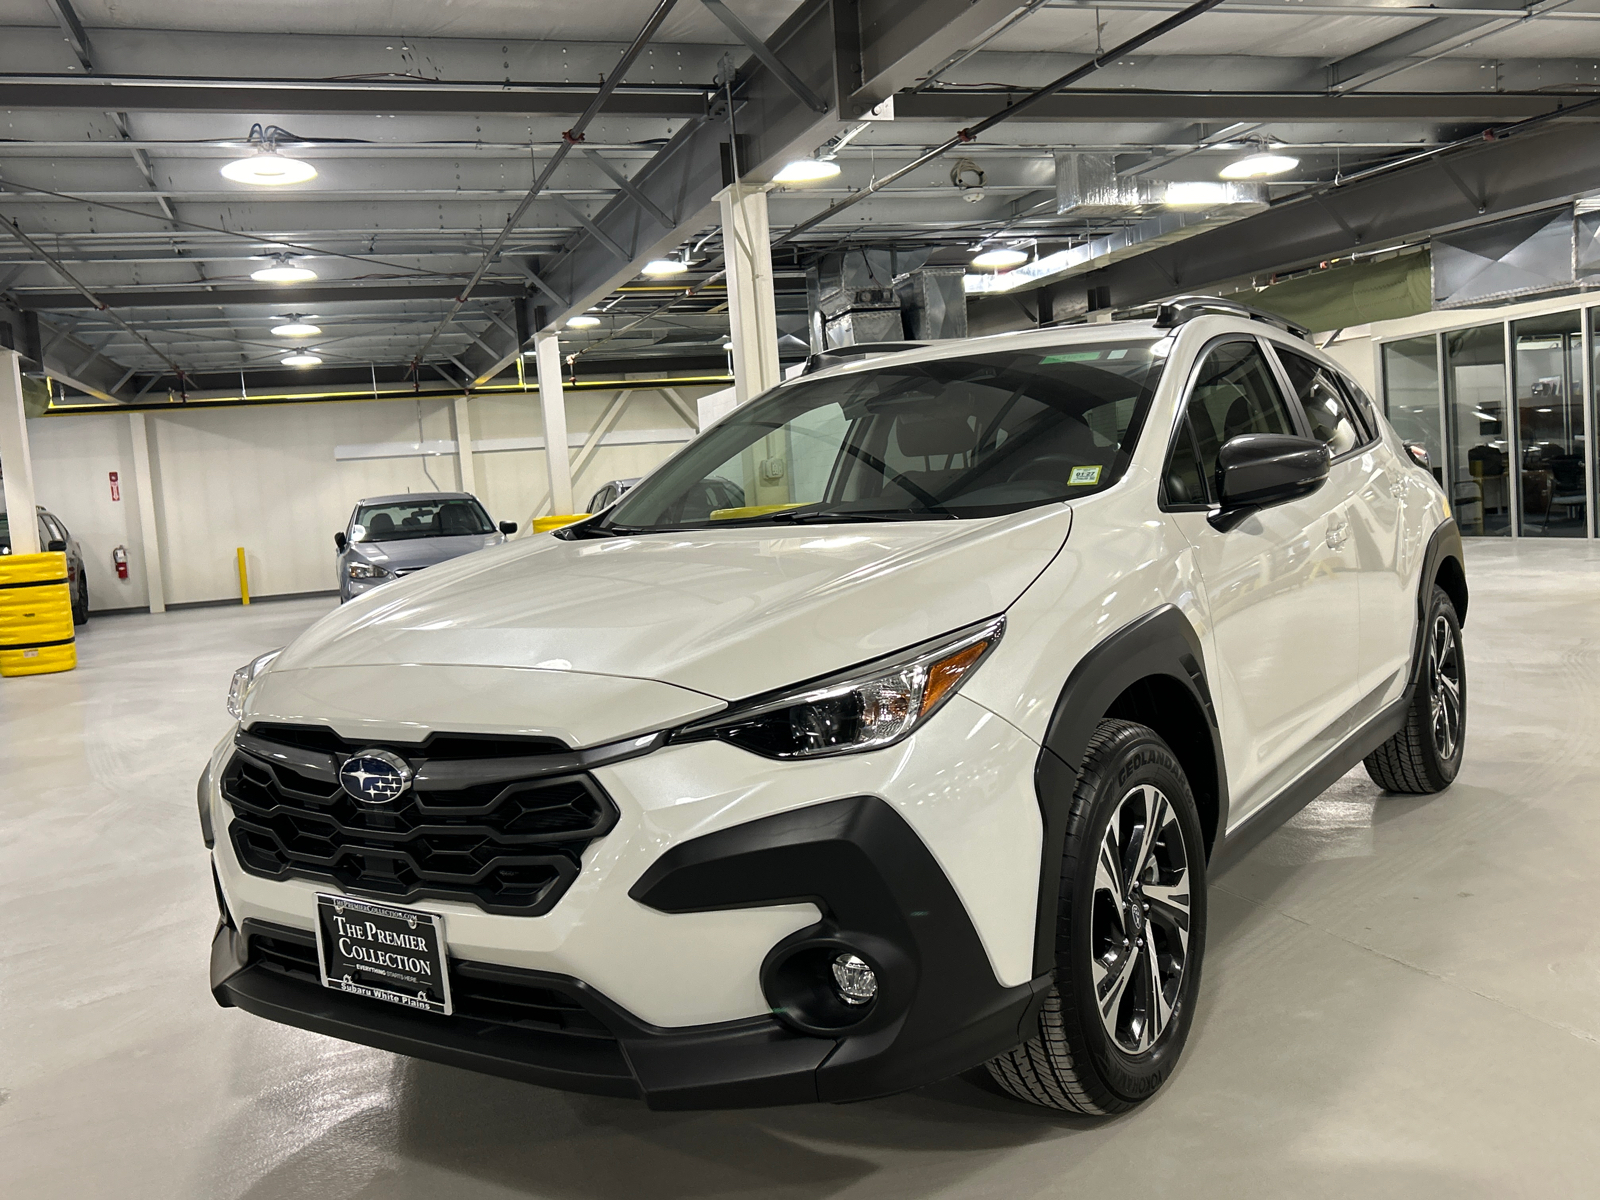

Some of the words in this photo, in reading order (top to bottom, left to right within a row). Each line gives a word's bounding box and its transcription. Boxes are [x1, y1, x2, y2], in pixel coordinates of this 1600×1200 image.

[333, 915, 365, 940] THE
[364, 921, 428, 953] PREMIER
[338, 937, 431, 976] COLLECTION
[340, 982, 372, 997] Subaru
[373, 989, 400, 1003] White
[401, 996, 431, 1010] Plains
